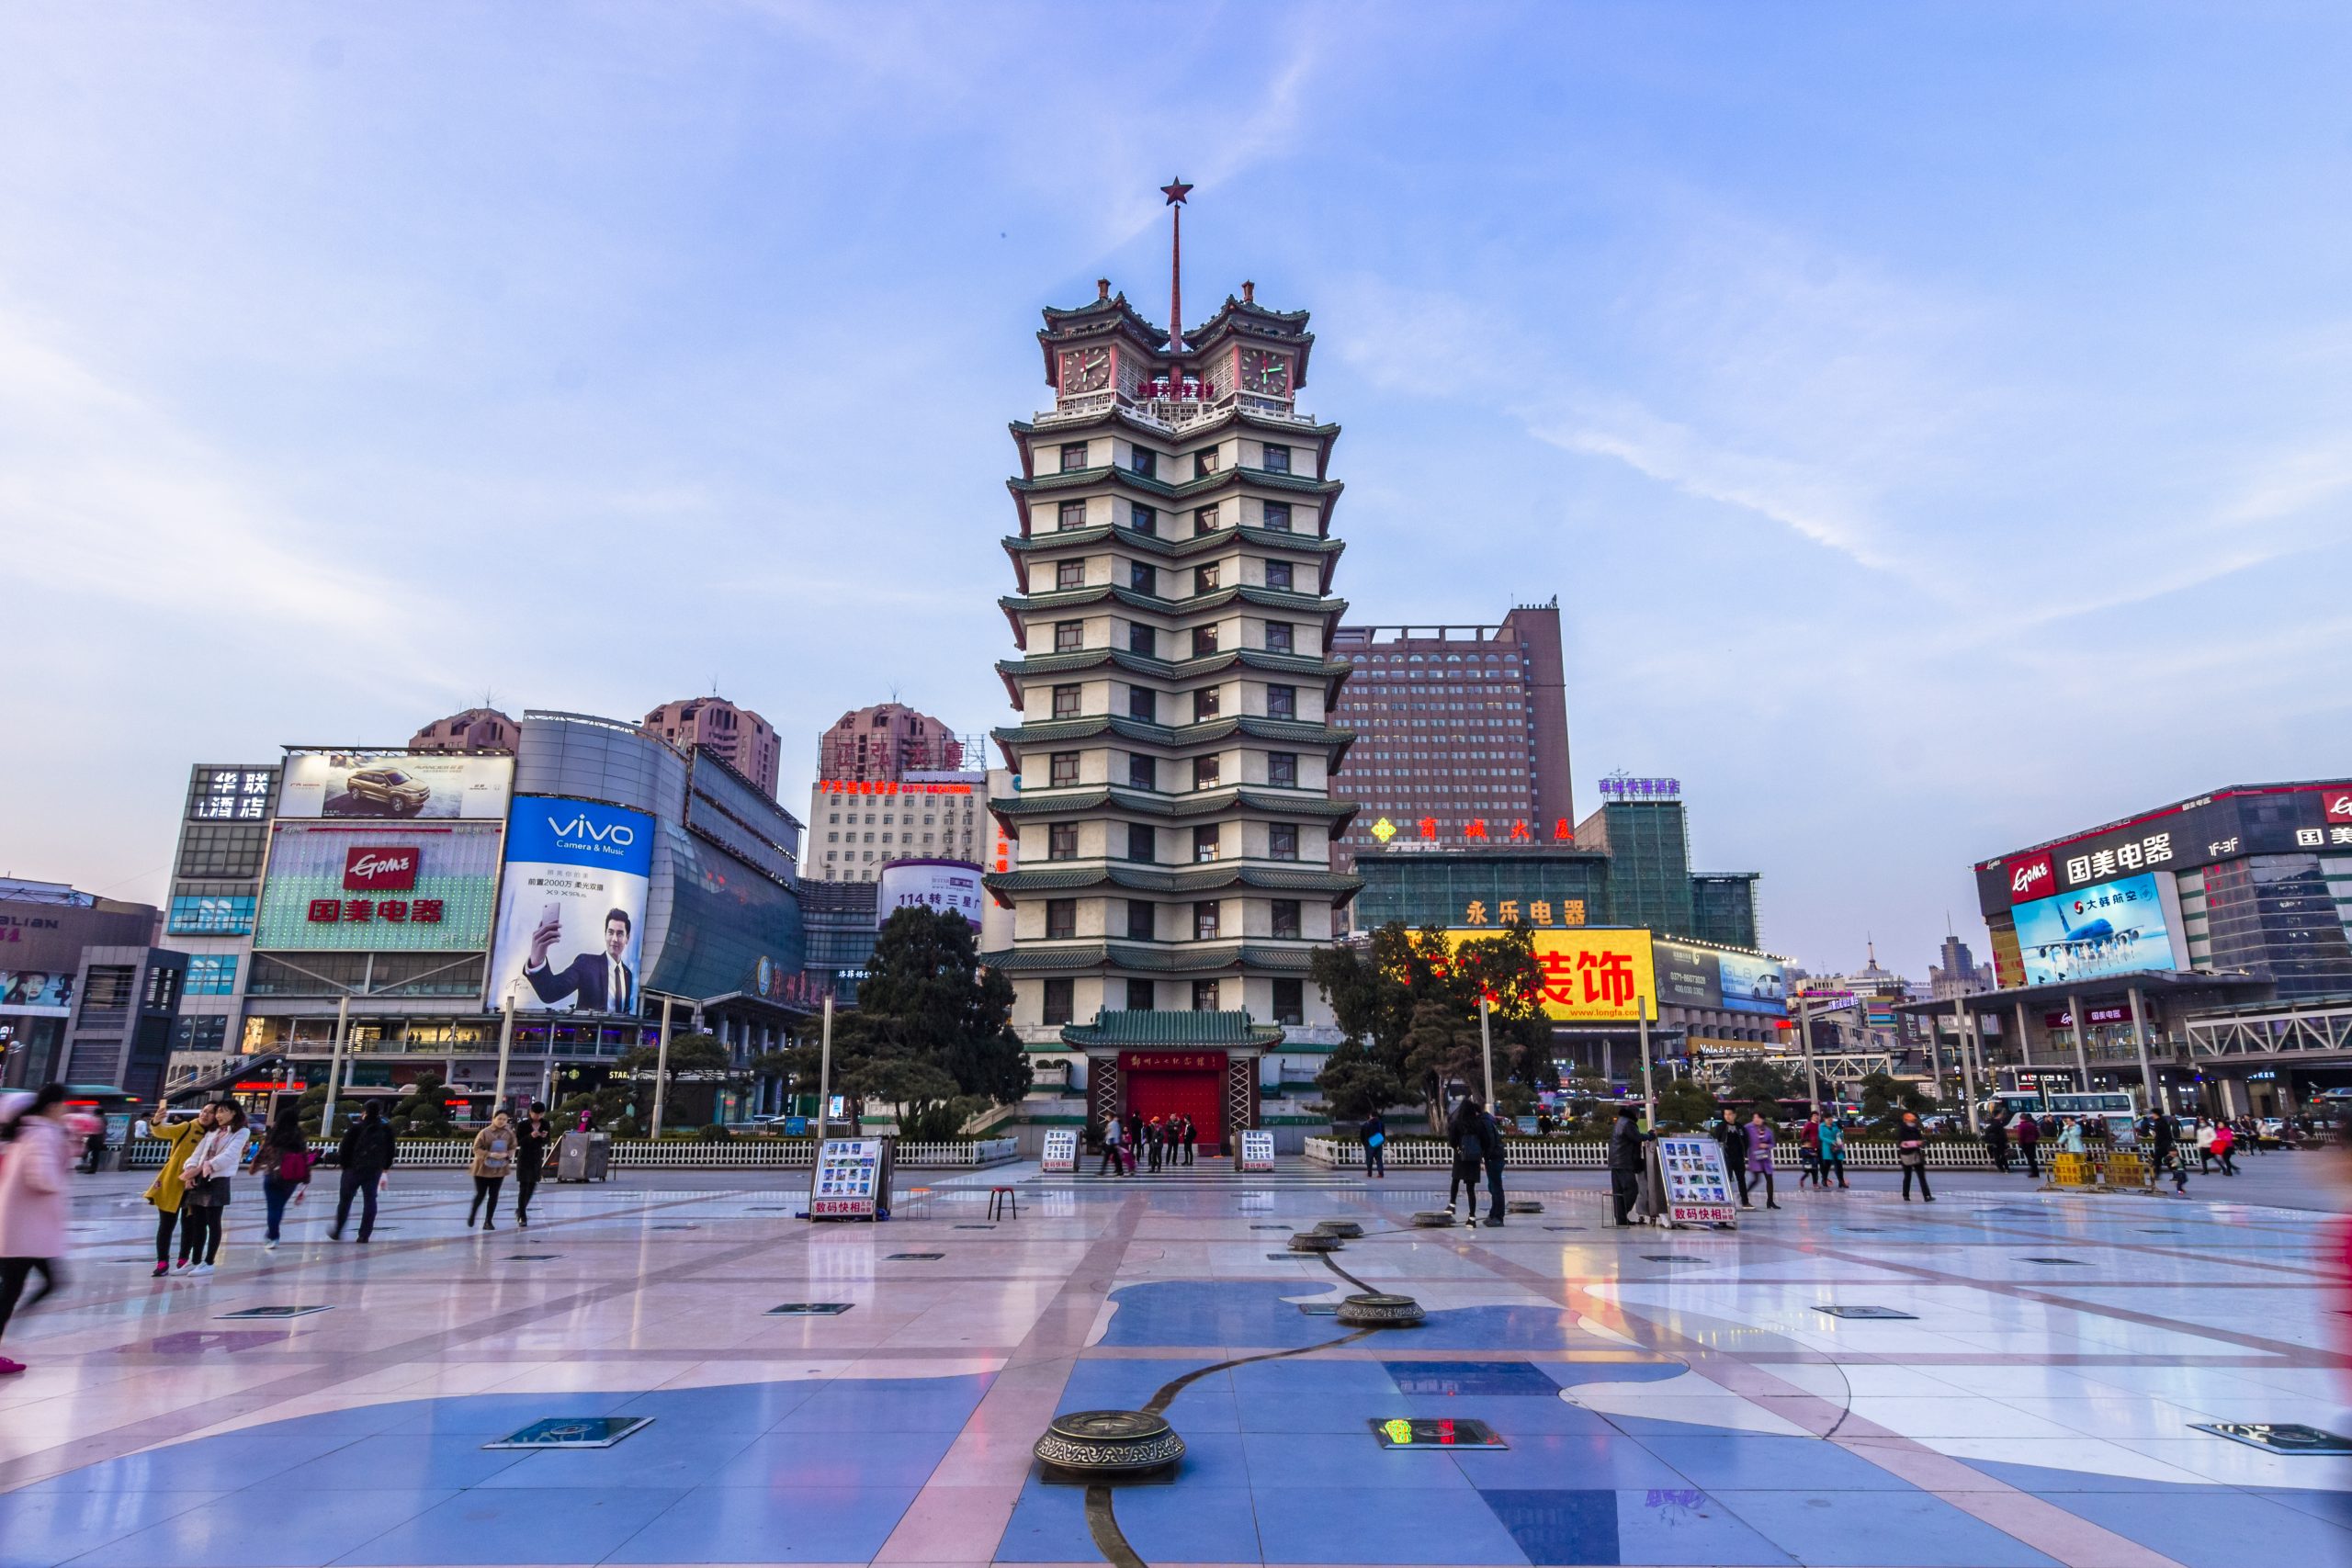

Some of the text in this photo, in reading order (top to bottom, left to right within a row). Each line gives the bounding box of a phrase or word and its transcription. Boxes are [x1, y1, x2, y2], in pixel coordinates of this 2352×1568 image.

[213, 773, 267, 794] 华联
[820, 780, 899, 795] 7天连锁酒店
[209, 796, 265, 818] 酒店
[548, 813, 634, 846] vivo
[556, 840, 592, 851] Camera
[602, 845, 625, 856] Music
[2066, 831, 2173, 886] 国美电器
[899, 893, 923, 905] 114
[2086, 890, 2137, 910] 大韩航空
[308, 899, 444, 923] 国美电器
[1466, 900, 1586, 925] 永乐电器
[2091, 1010, 2121, 1020] 国美电器
[816, 1201, 861, 1213] 数码快相
[1675, 1208, 1722, 1220] 数码快相
